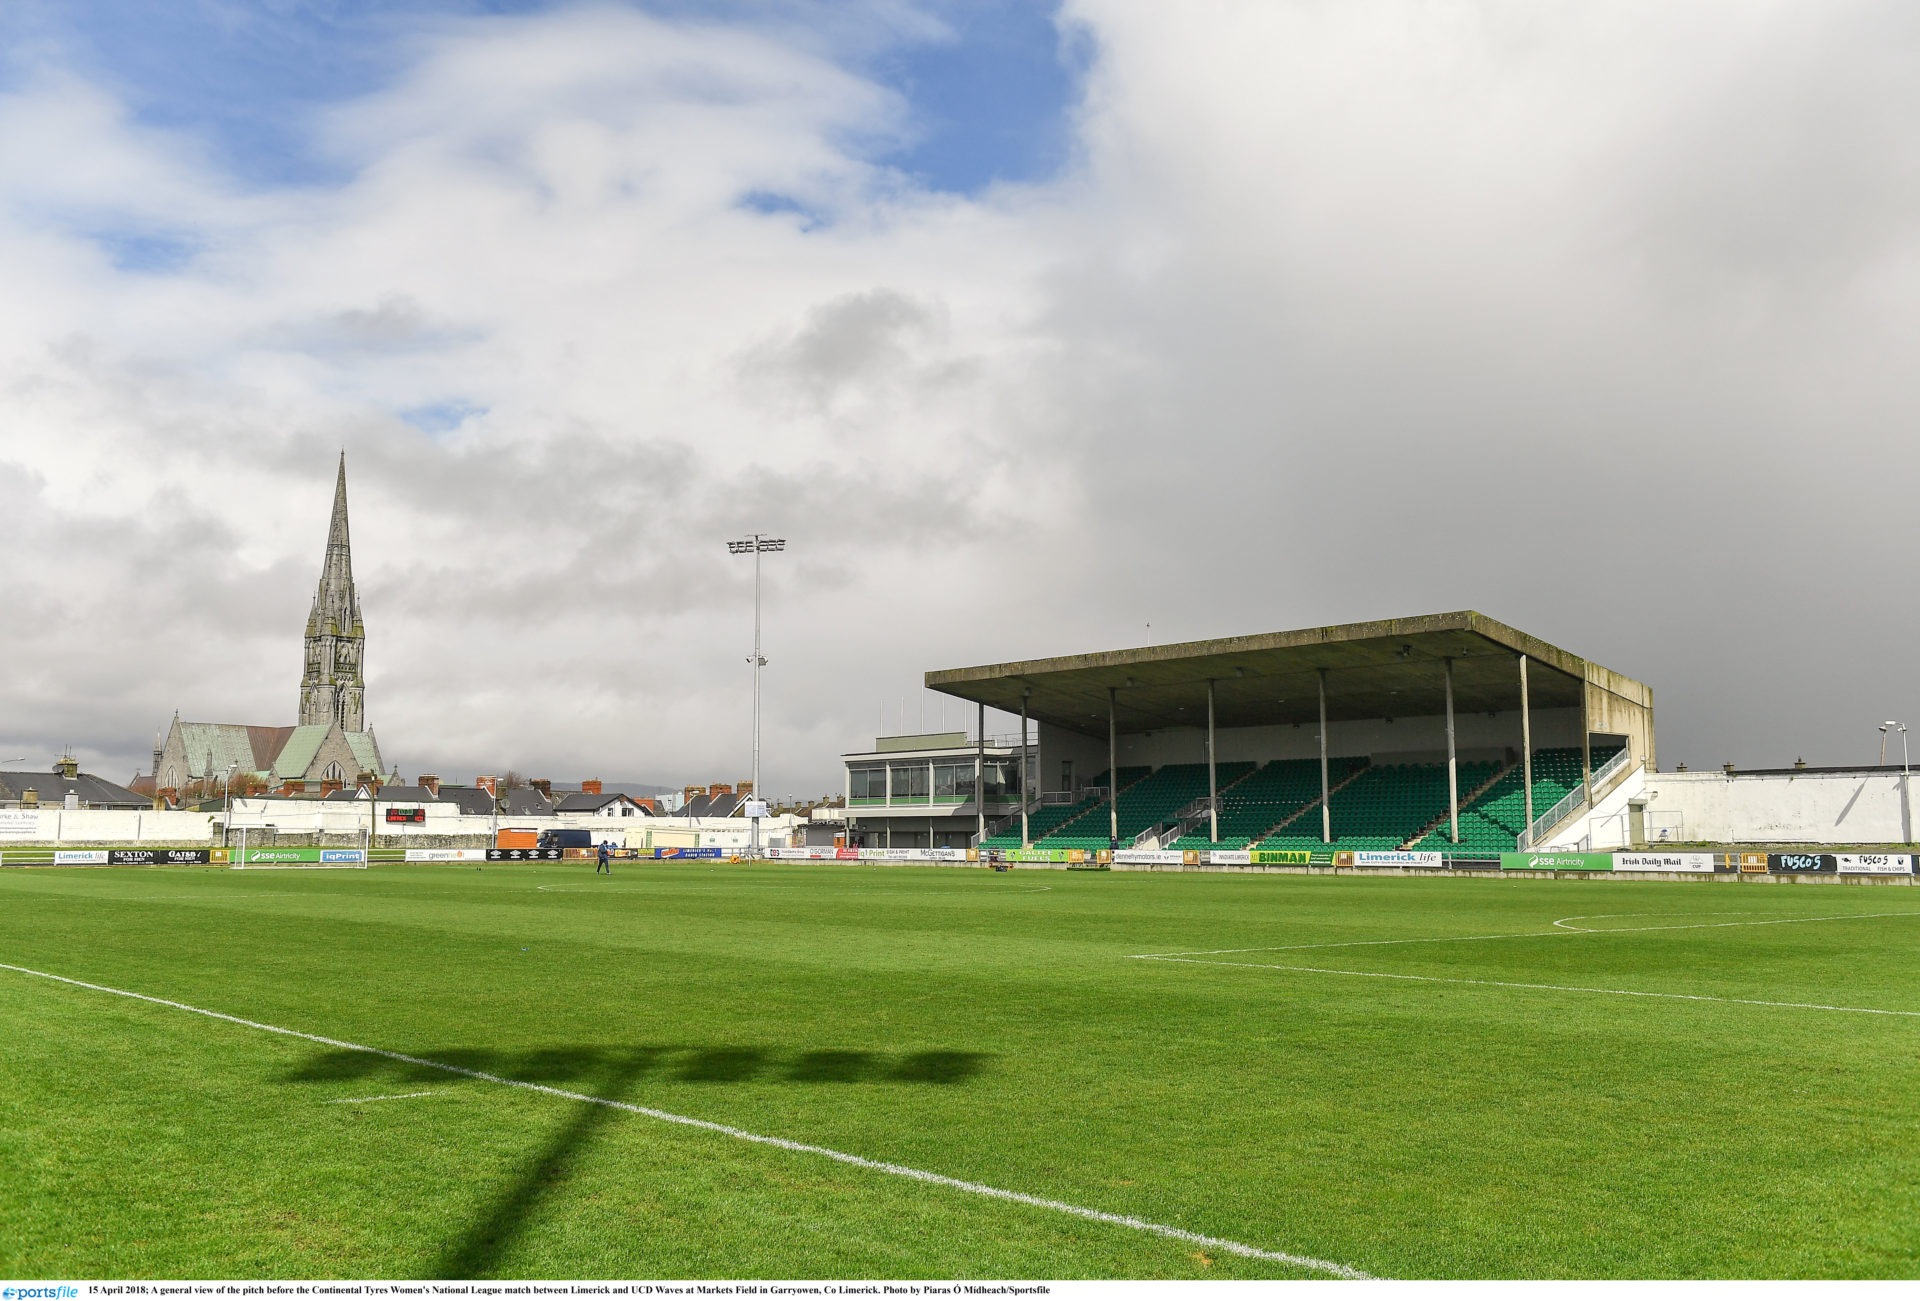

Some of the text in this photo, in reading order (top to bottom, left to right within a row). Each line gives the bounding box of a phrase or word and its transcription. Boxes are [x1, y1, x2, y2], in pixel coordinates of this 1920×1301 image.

[275, 852, 300, 860] Airtricity
[869, 849, 885, 857] Print
[1258, 852, 1307, 863] BINMAN
[1358, 853, 1416, 861] Limerick
[1419, 853, 1437, 863] life
[1539, 857, 1585, 867] sse Airtricity
[1622, 857, 1682, 867] Irish Daily Mail
[1781, 855, 1821, 870] FUSCO'S
[1858, 855, 1889, 866] FUSCOS
